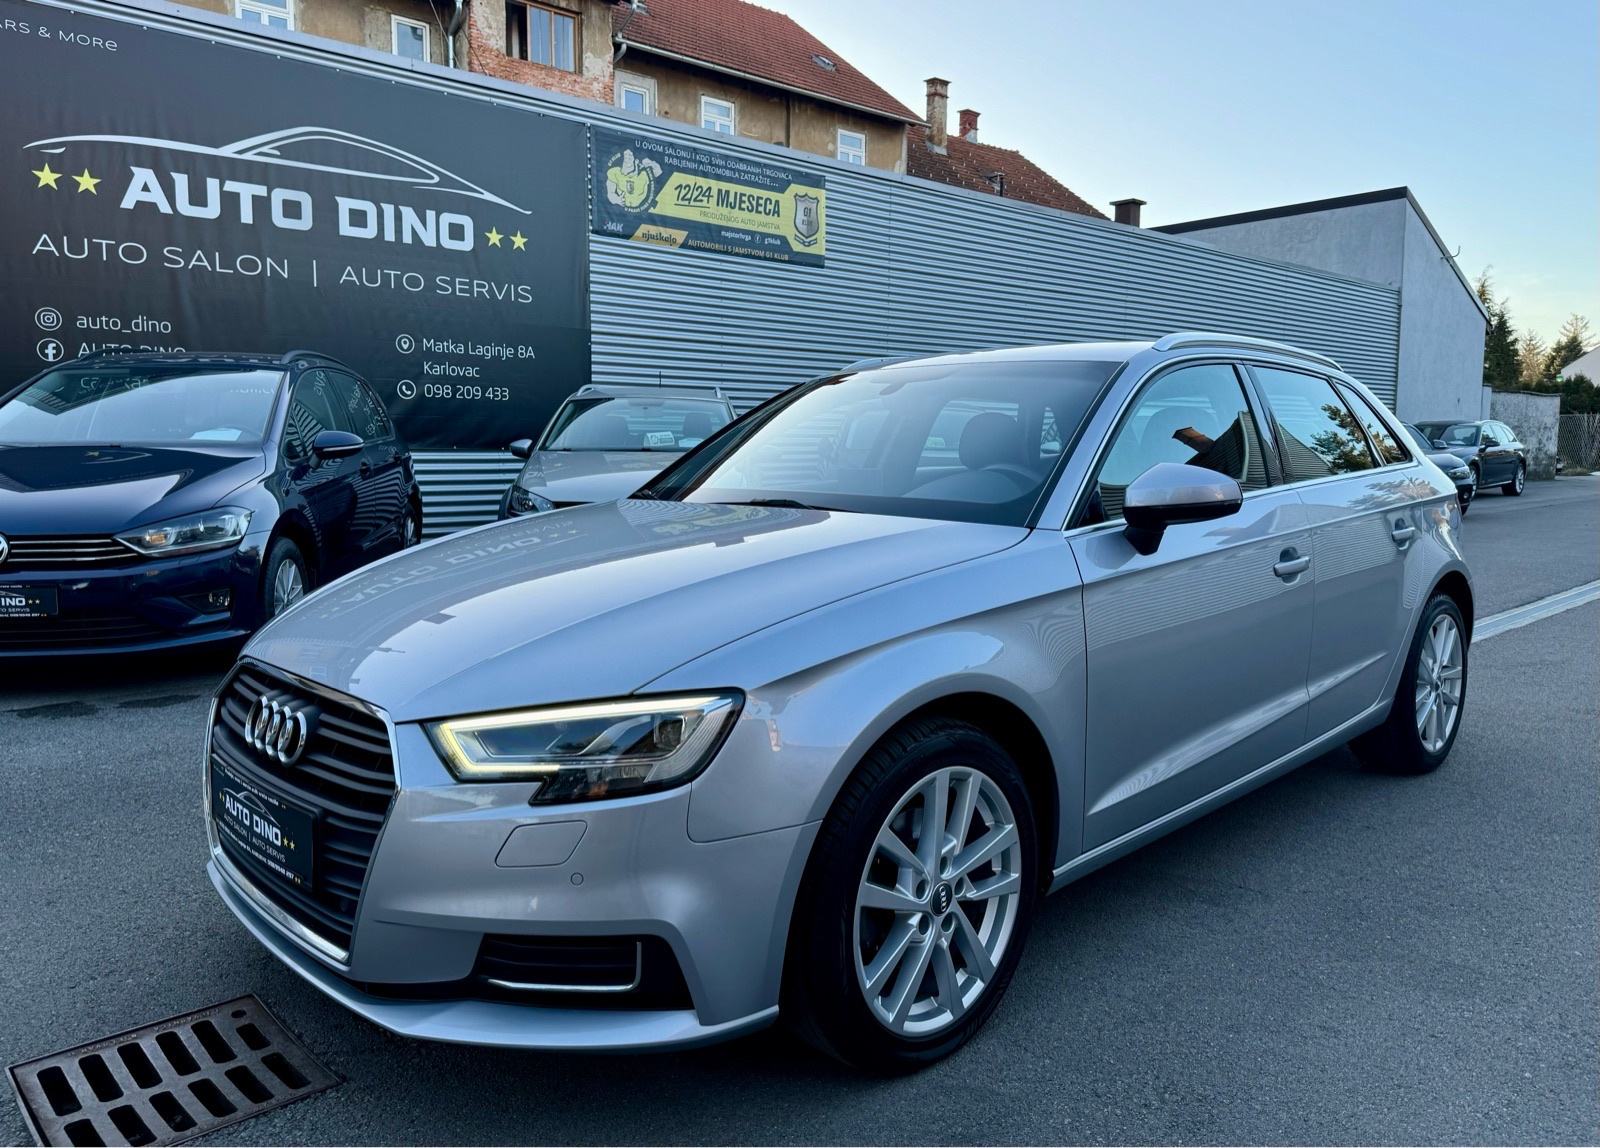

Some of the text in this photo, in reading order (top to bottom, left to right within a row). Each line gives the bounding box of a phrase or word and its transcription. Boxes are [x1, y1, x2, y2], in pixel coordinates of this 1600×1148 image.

[0, 19, 30, 34] RS
[38, 26, 51, 38] &
[635, 140, 641, 148] U
[642, 141, 663, 153] OVOM
[664, 146, 691, 160] SALONU
[726, 160, 761, 175] ODABRANIH
[763, 168, 793, 181] TRGOVACA
[664, 156, 698, 170] RABLJENIH
[699, 164, 740, 179] AUTOMOBILA
[119, 165, 474, 252] AUTO DINO
[674, 182, 714, 205] 12/24
[716, 188, 781, 218] MJESECA
[740, 217, 756, 227] AUTO
[732, 246, 765, 258] JAMSTVOM
[32, 233, 147, 264] AUTO
[163, 246, 288, 279] SALON
[339, 266, 425, 292] AUTO
[436, 275, 533, 304] SERVIS
[76, 314, 172, 334] auto_dino
[422, 338, 536, 361] Matka Laginje 8A
[423, 361, 480, 378] Karlovac
[424, 383, 510, 401] 098 209 433
[0, 597, 26, 606] INO
[225, 794, 282, 847] AUTO DINO
